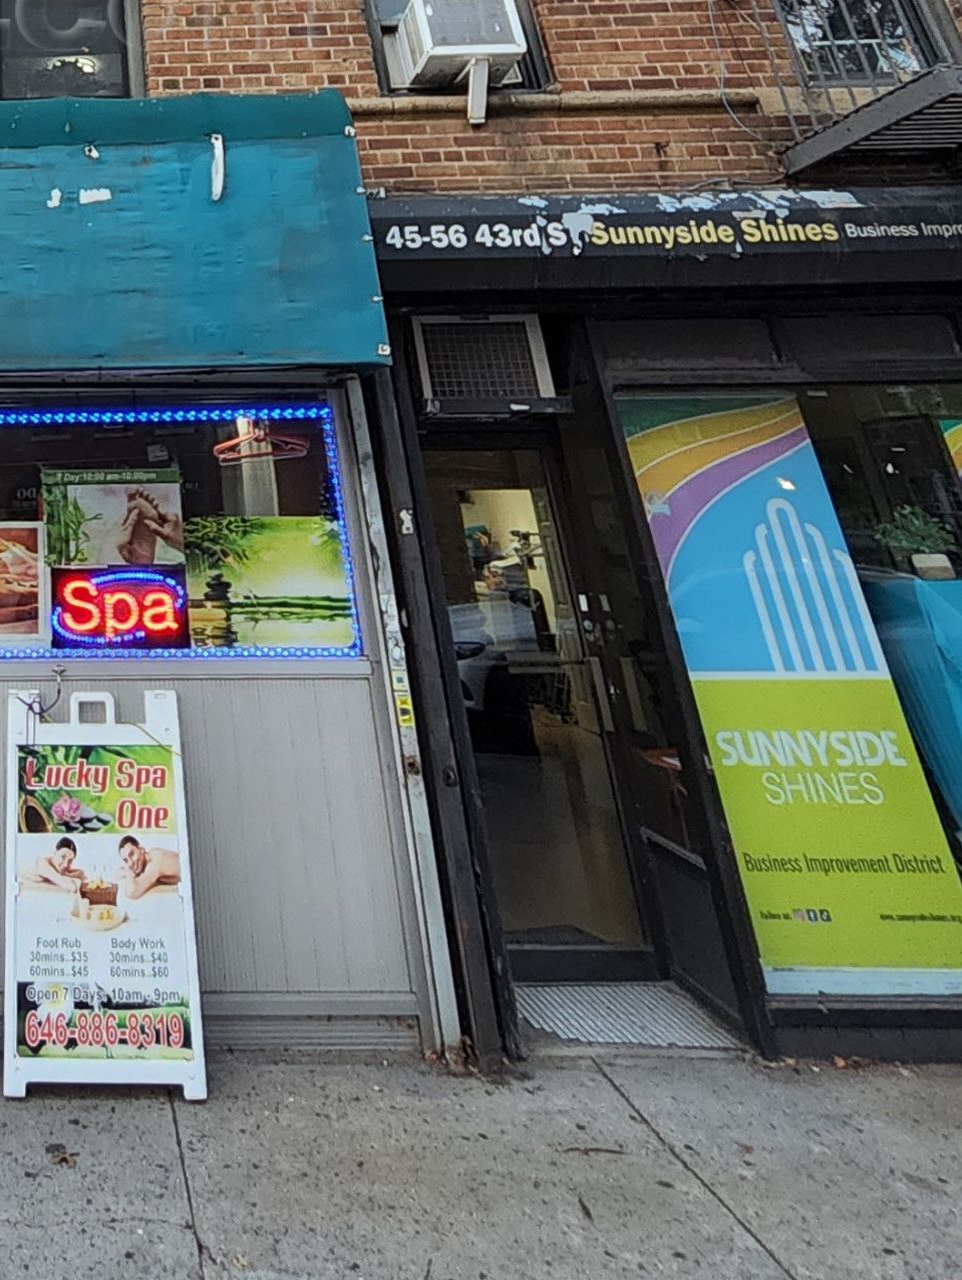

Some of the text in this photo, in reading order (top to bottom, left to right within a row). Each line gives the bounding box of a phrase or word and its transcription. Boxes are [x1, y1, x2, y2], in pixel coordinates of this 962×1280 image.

[386, 224, 467, 249] 45-56
[475, 223, 542, 248] 43rd
[591, 221, 735, 250] Sunnyside
[741, 219, 839, 243] Shines
[845, 223, 918, 238] Business
[63, 579, 178, 639] Spa
[716, 730, 907, 767] SUNNYSIDE
[25, 757, 167, 794] Lucky Spa
[762, 771, 885, 805] SHINES
[117, 799, 169, 829] One
[742, 851, 946, 877] Business Improvement District
[36, 936, 81, 949] Foot Rub
[111, 937, 166, 951] Body Work
[27, 986, 59, 1005] Open
[63, 986, 69, 1001] 7
[112, 987, 143, 1001] 10am
[154, 987, 181, 1004] 9pm
[26, 1012, 184, 1047] 646-886-8319
